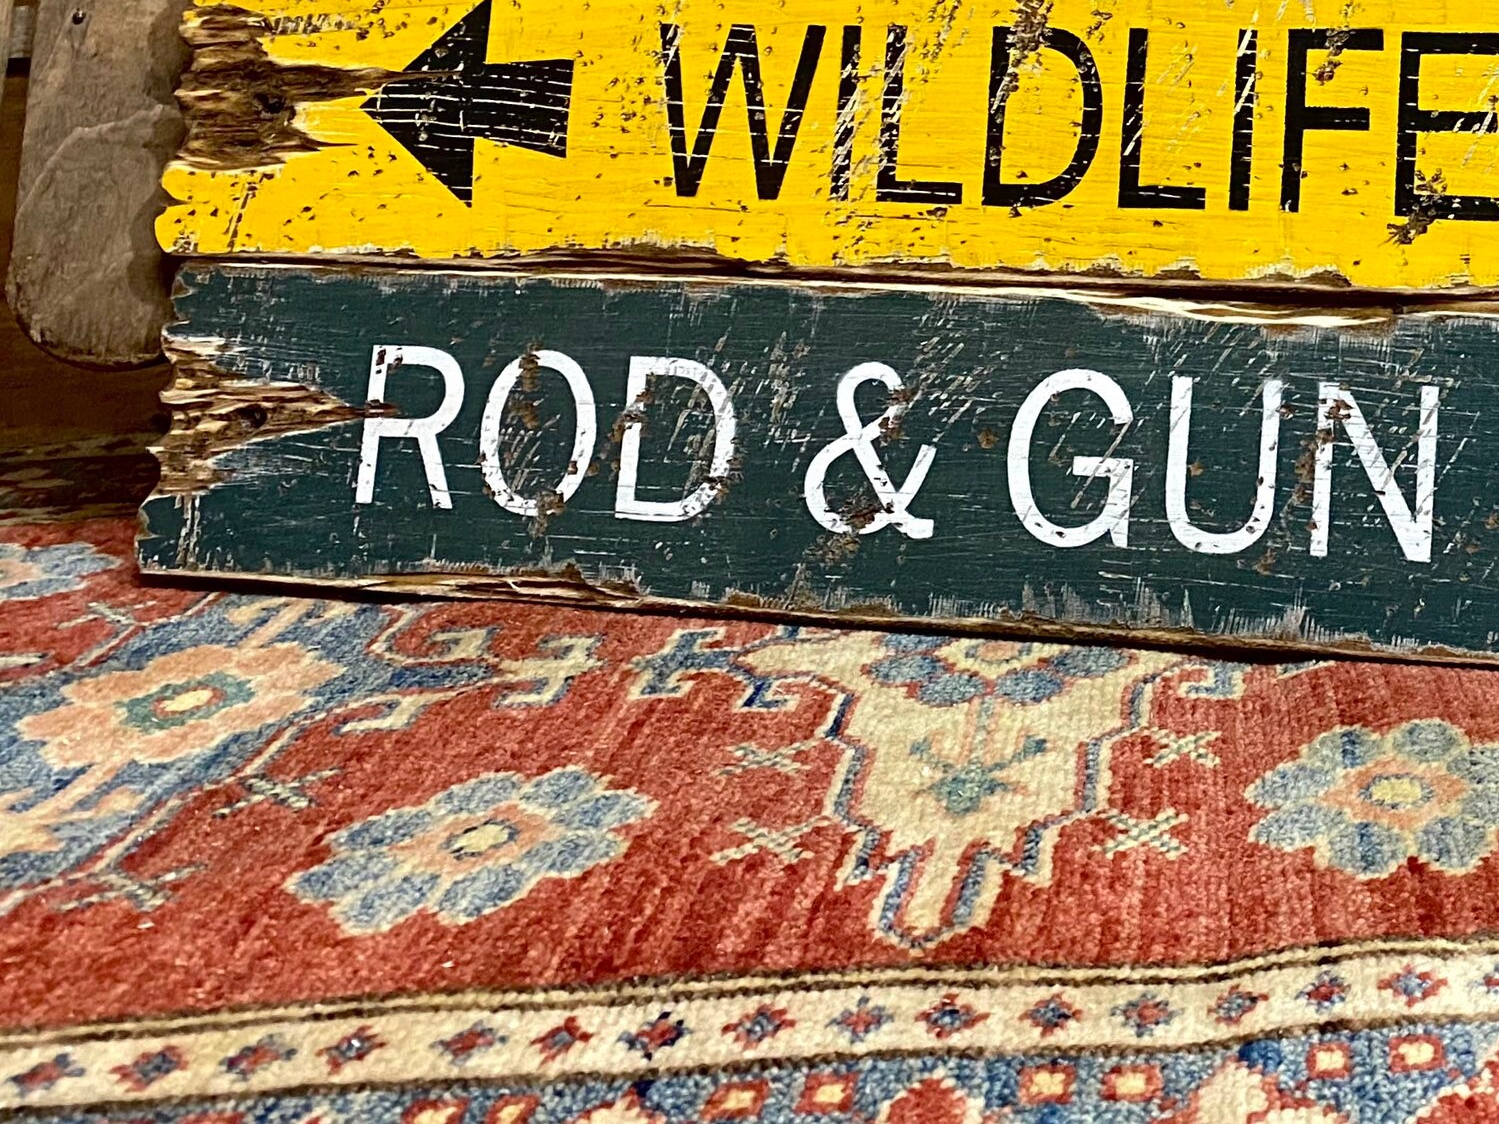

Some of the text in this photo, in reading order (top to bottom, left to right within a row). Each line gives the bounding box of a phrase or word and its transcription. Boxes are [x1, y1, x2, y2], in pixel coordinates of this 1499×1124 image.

[355, 344, 738, 523] ROD
[803, 361, 936, 539] &
[1007, 368, 1440, 563] GUN
